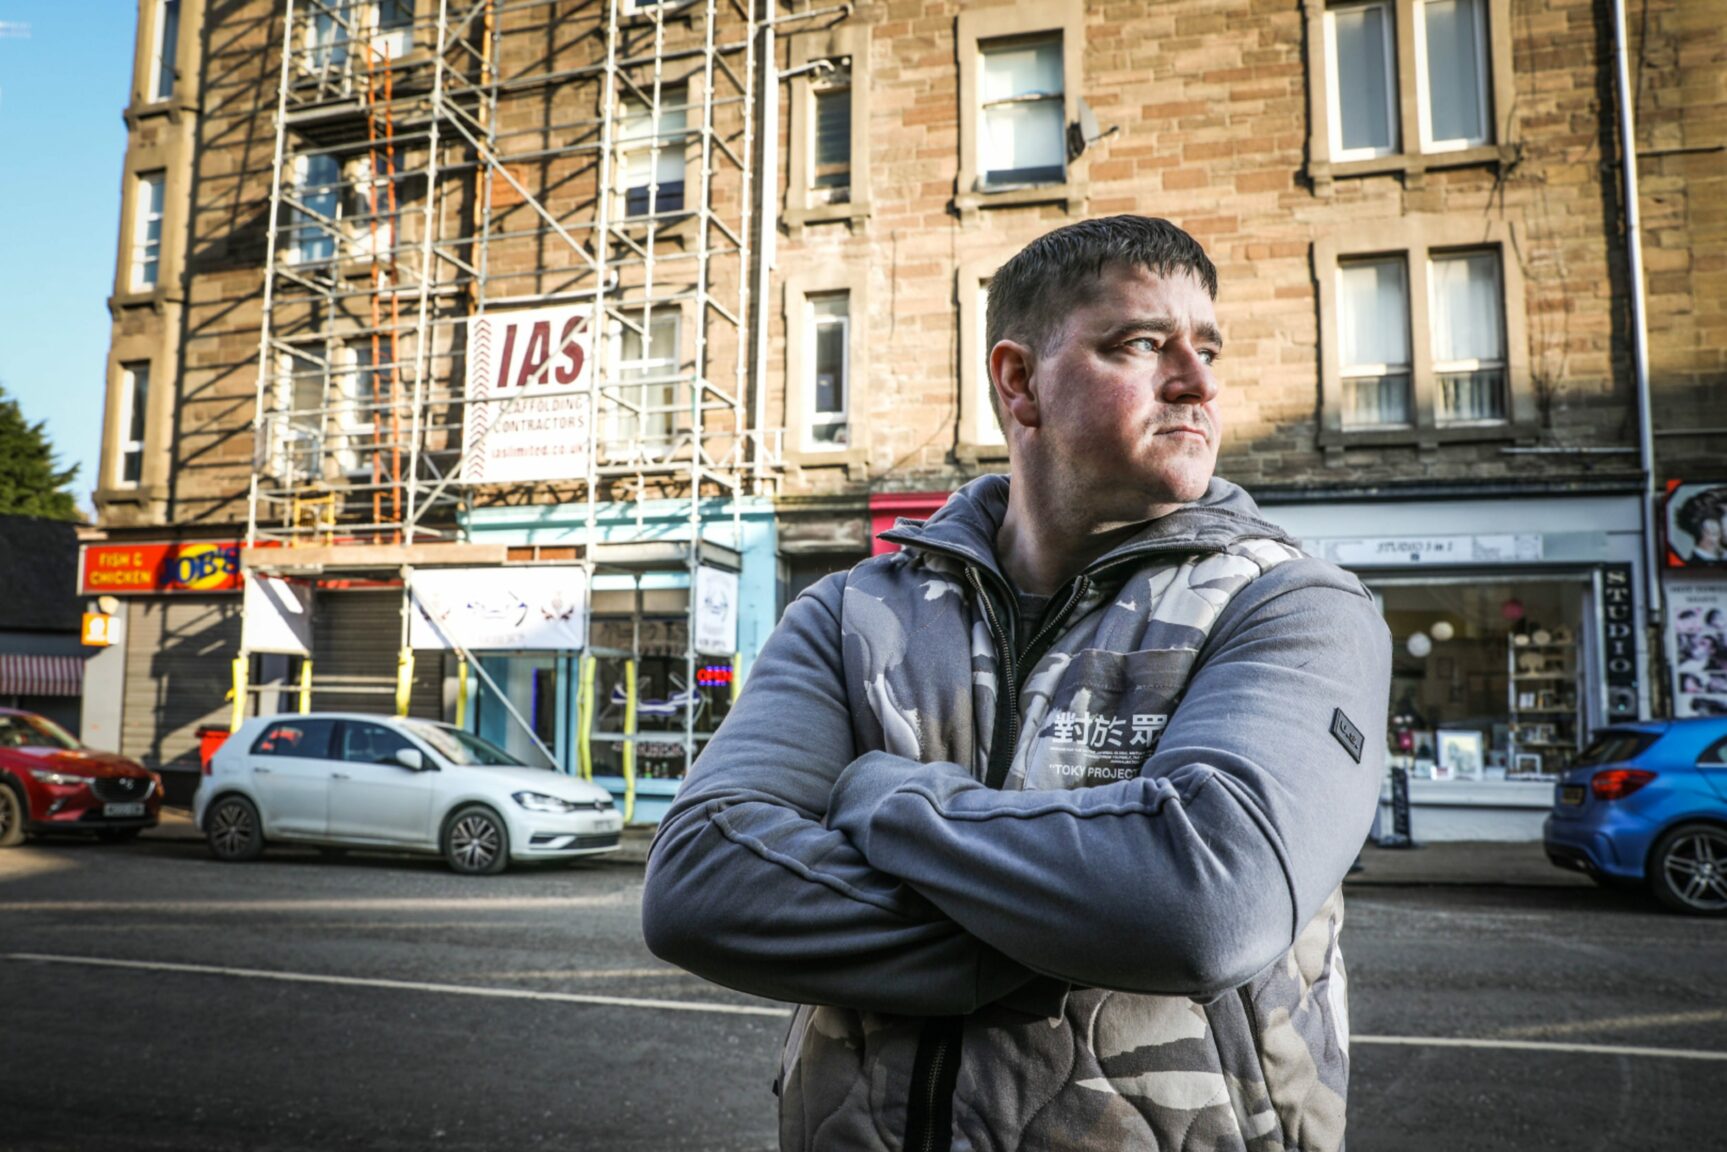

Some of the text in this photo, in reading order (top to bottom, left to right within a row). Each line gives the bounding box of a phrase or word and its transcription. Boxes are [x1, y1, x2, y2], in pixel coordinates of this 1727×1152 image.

[497, 315, 588, 388] IAS
[494, 415, 586, 434] CONTRACTORS
[99, 552, 130, 567] FISH
[89, 571, 152, 585] CHICKEN
[1605, 571, 1632, 672] STUDIO
